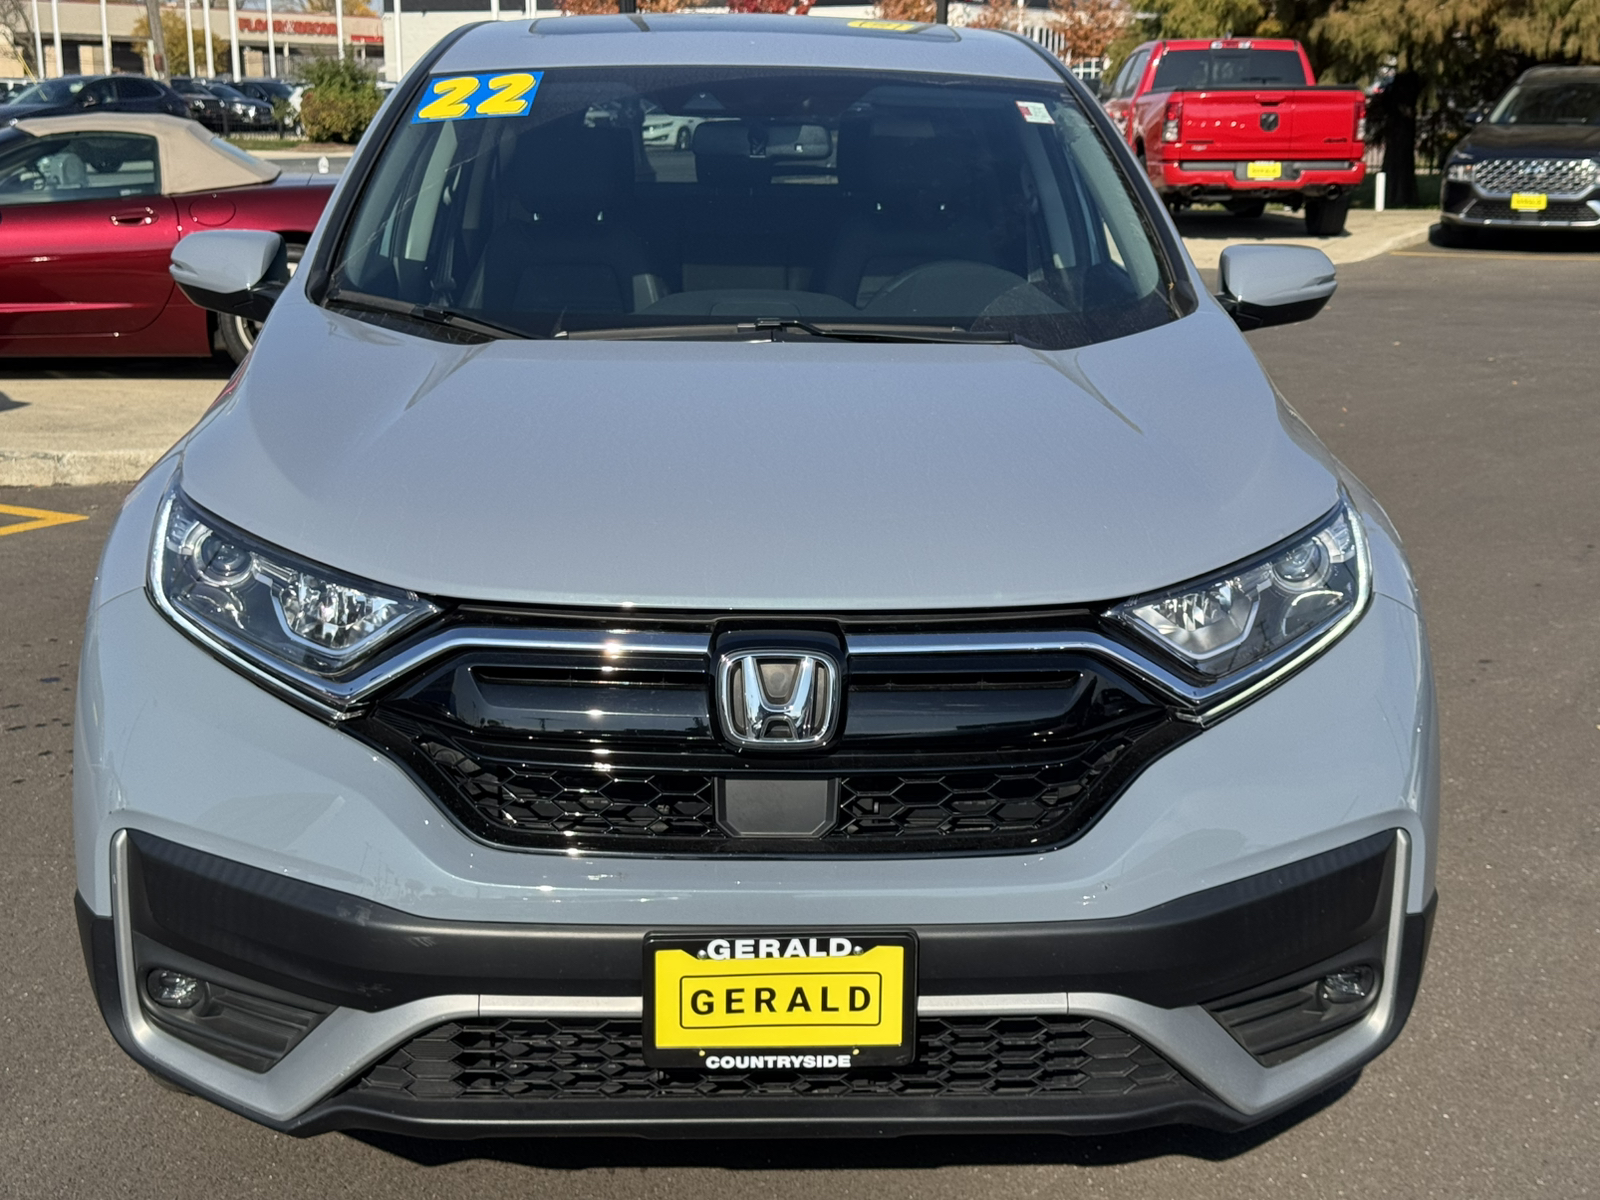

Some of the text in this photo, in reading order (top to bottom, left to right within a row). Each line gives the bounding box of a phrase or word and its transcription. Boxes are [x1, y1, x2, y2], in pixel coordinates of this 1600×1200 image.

[418, 73, 537, 120] 22
[706, 937, 852, 961] GERALD
[690, 985, 871, 1015] GERALD
[705, 1054, 851, 1069] COUNTRYSIDE
